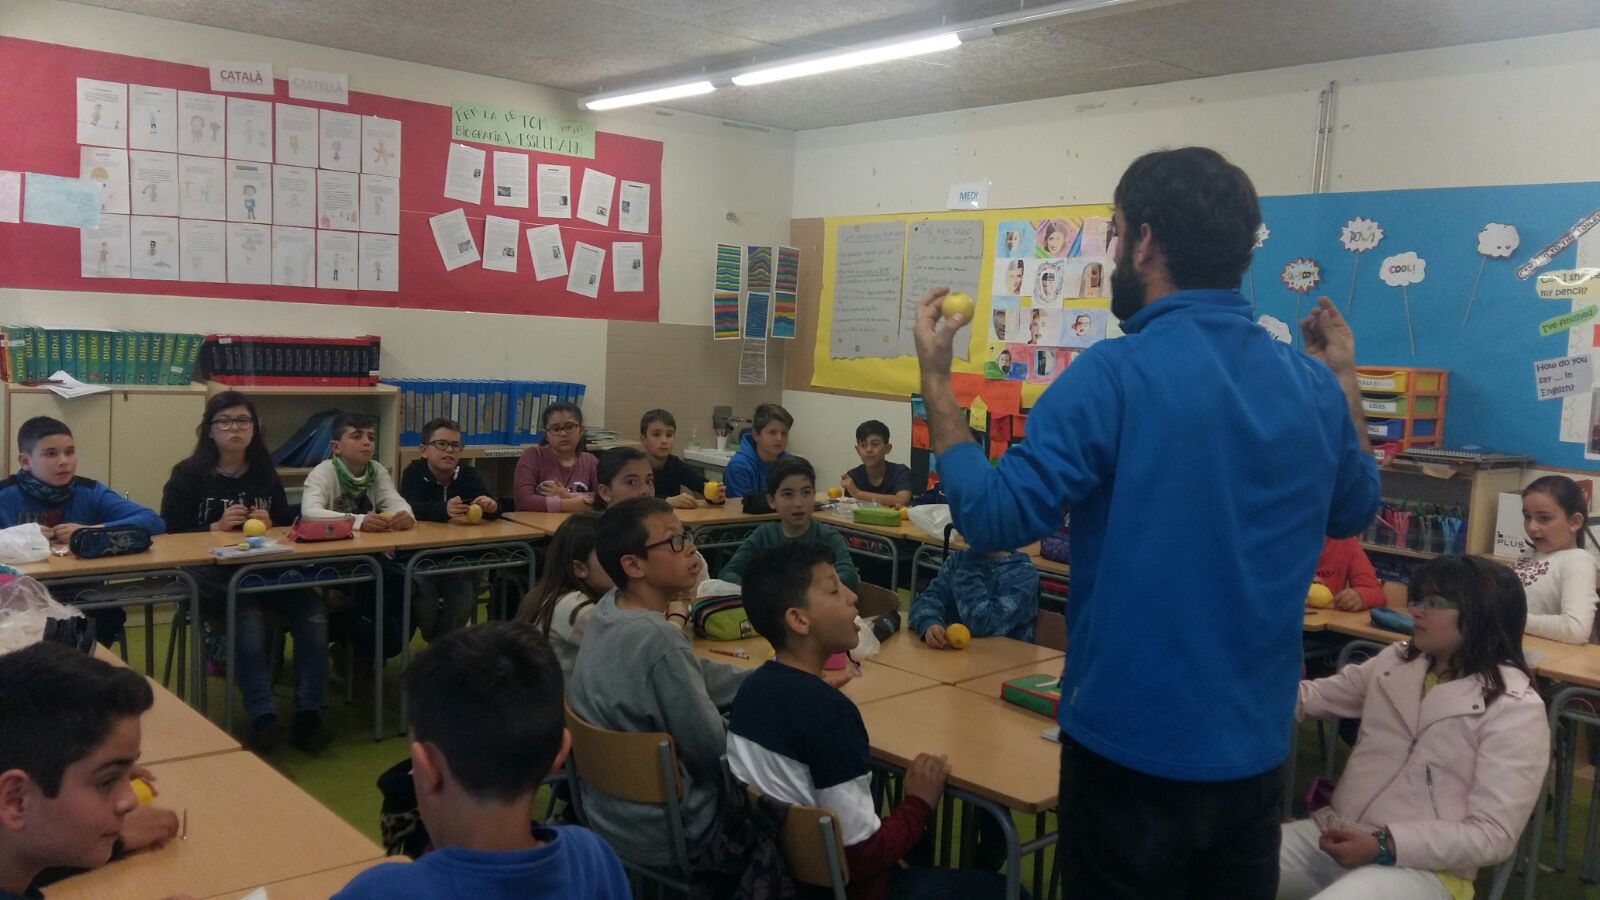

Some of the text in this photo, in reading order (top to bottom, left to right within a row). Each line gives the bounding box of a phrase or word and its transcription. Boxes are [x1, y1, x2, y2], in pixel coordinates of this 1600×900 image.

[220, 69, 264, 84] CATALÀ
[1389, 264, 1416, 275] COOL!
[1541, 287, 1588, 297] my pencil?
[1542, 309, 1593, 334] I've finished
[1536, 356, 1588, 371] How do you
[1539, 377, 1552, 385] say
[1540, 385, 1575, 398] English?
[1497, 538, 1525, 548] PLUS
